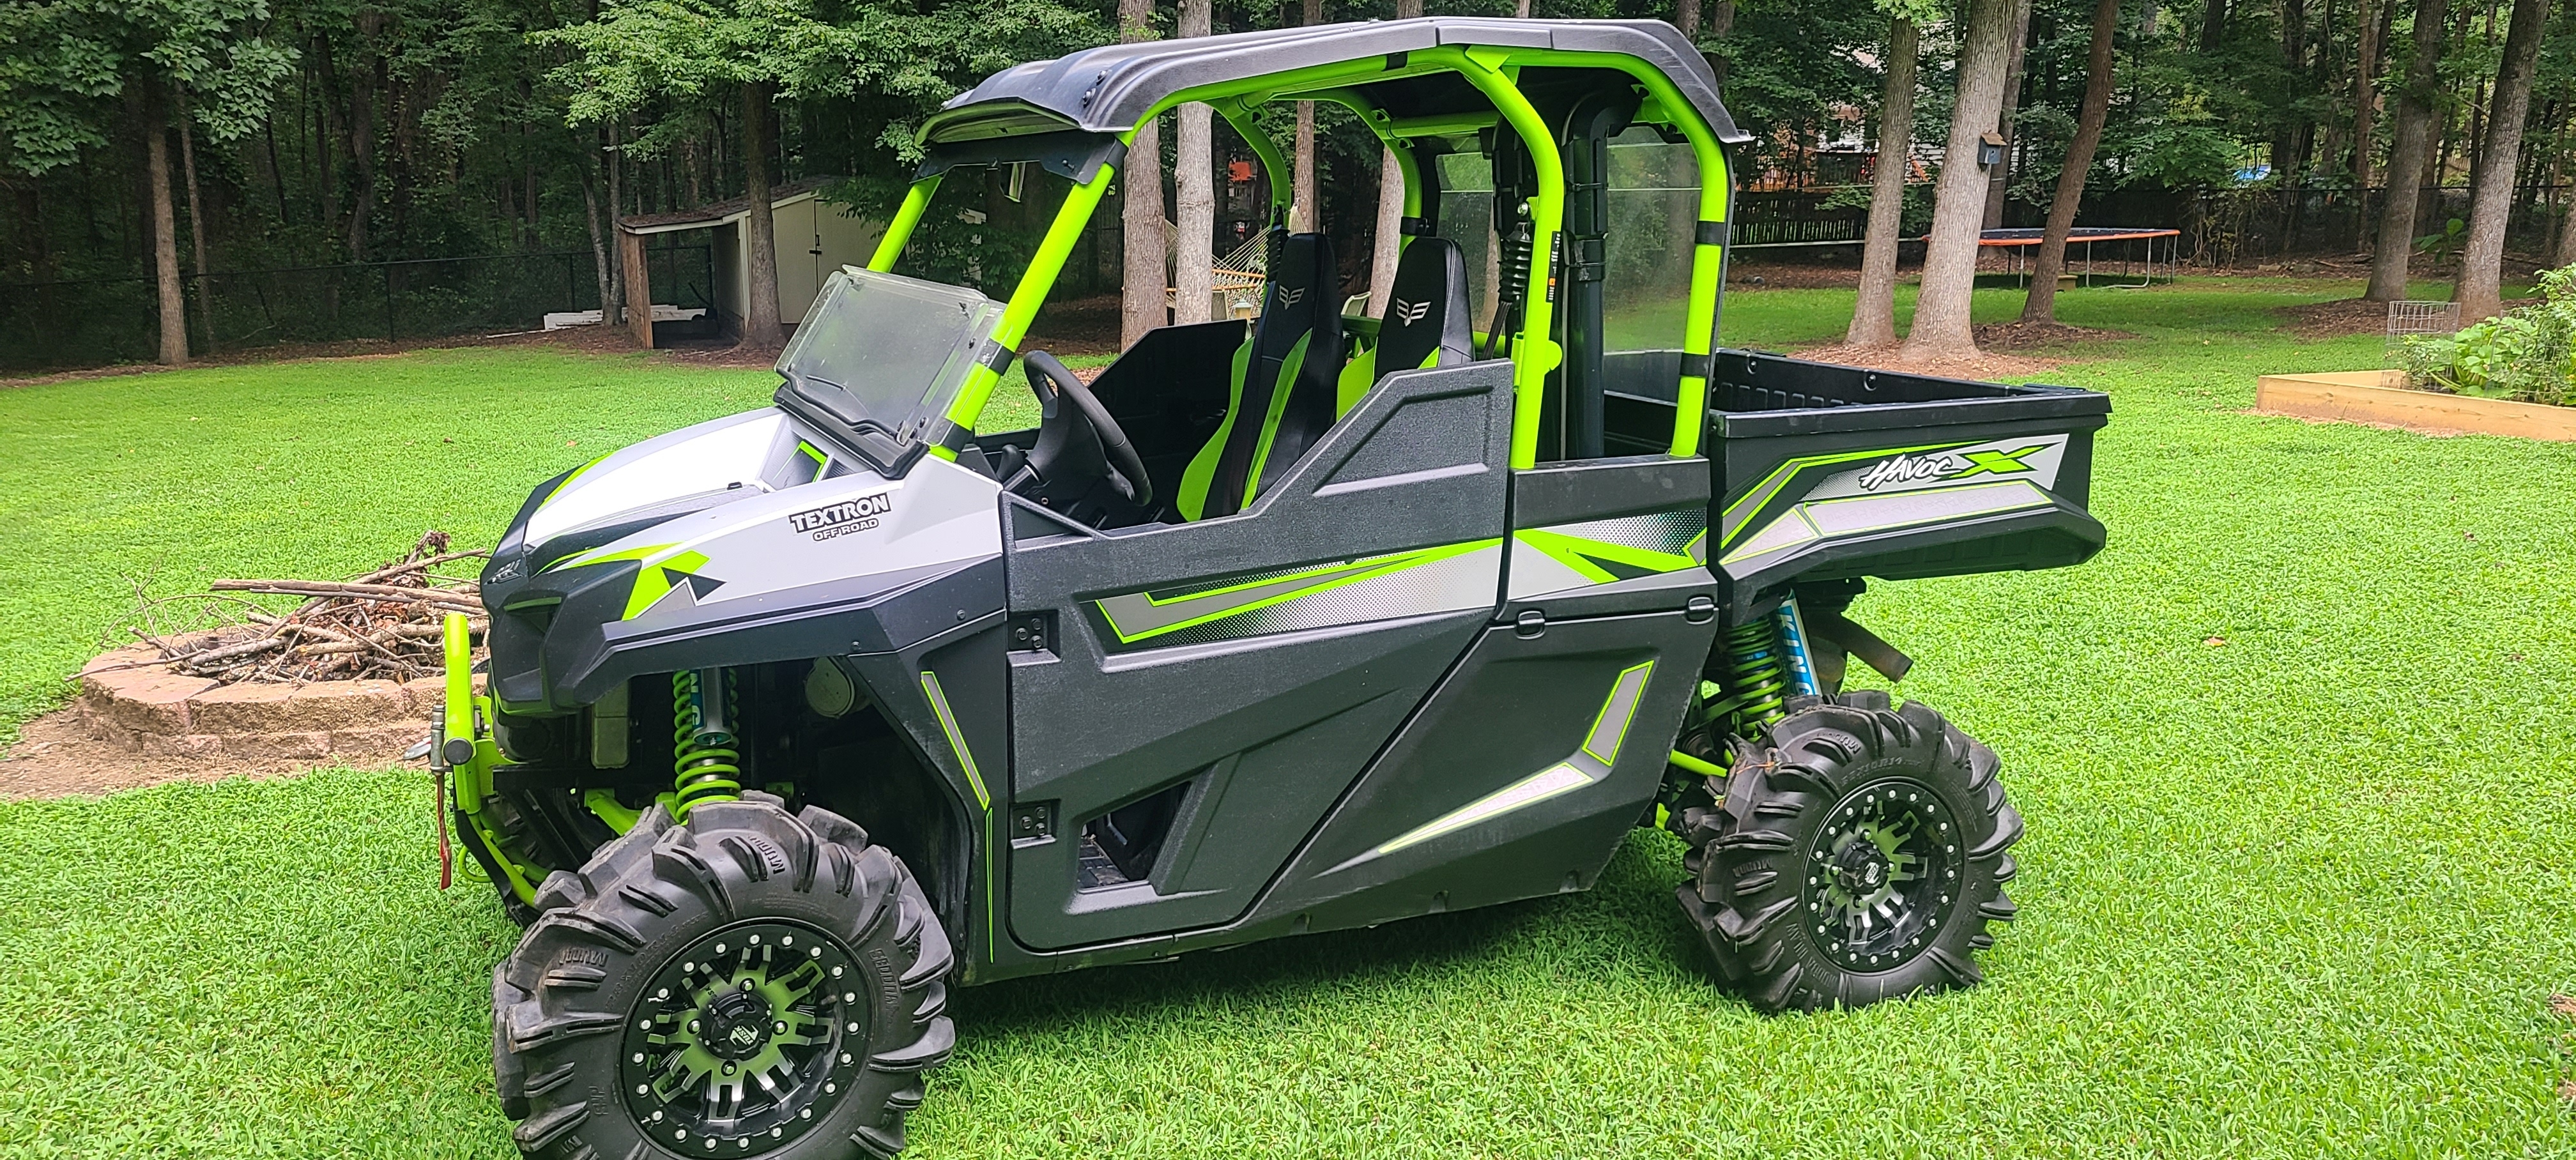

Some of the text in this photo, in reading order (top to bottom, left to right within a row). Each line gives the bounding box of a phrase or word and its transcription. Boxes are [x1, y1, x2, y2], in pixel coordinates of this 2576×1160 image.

[1859, 452, 1962, 491] HAVOC
[790, 493, 891, 533] TEXTRON
[813, 518, 879, 542] OFF ROAD
[1776, 613, 1814, 695] KING
[733, 1025, 754, 1046] TUSK
